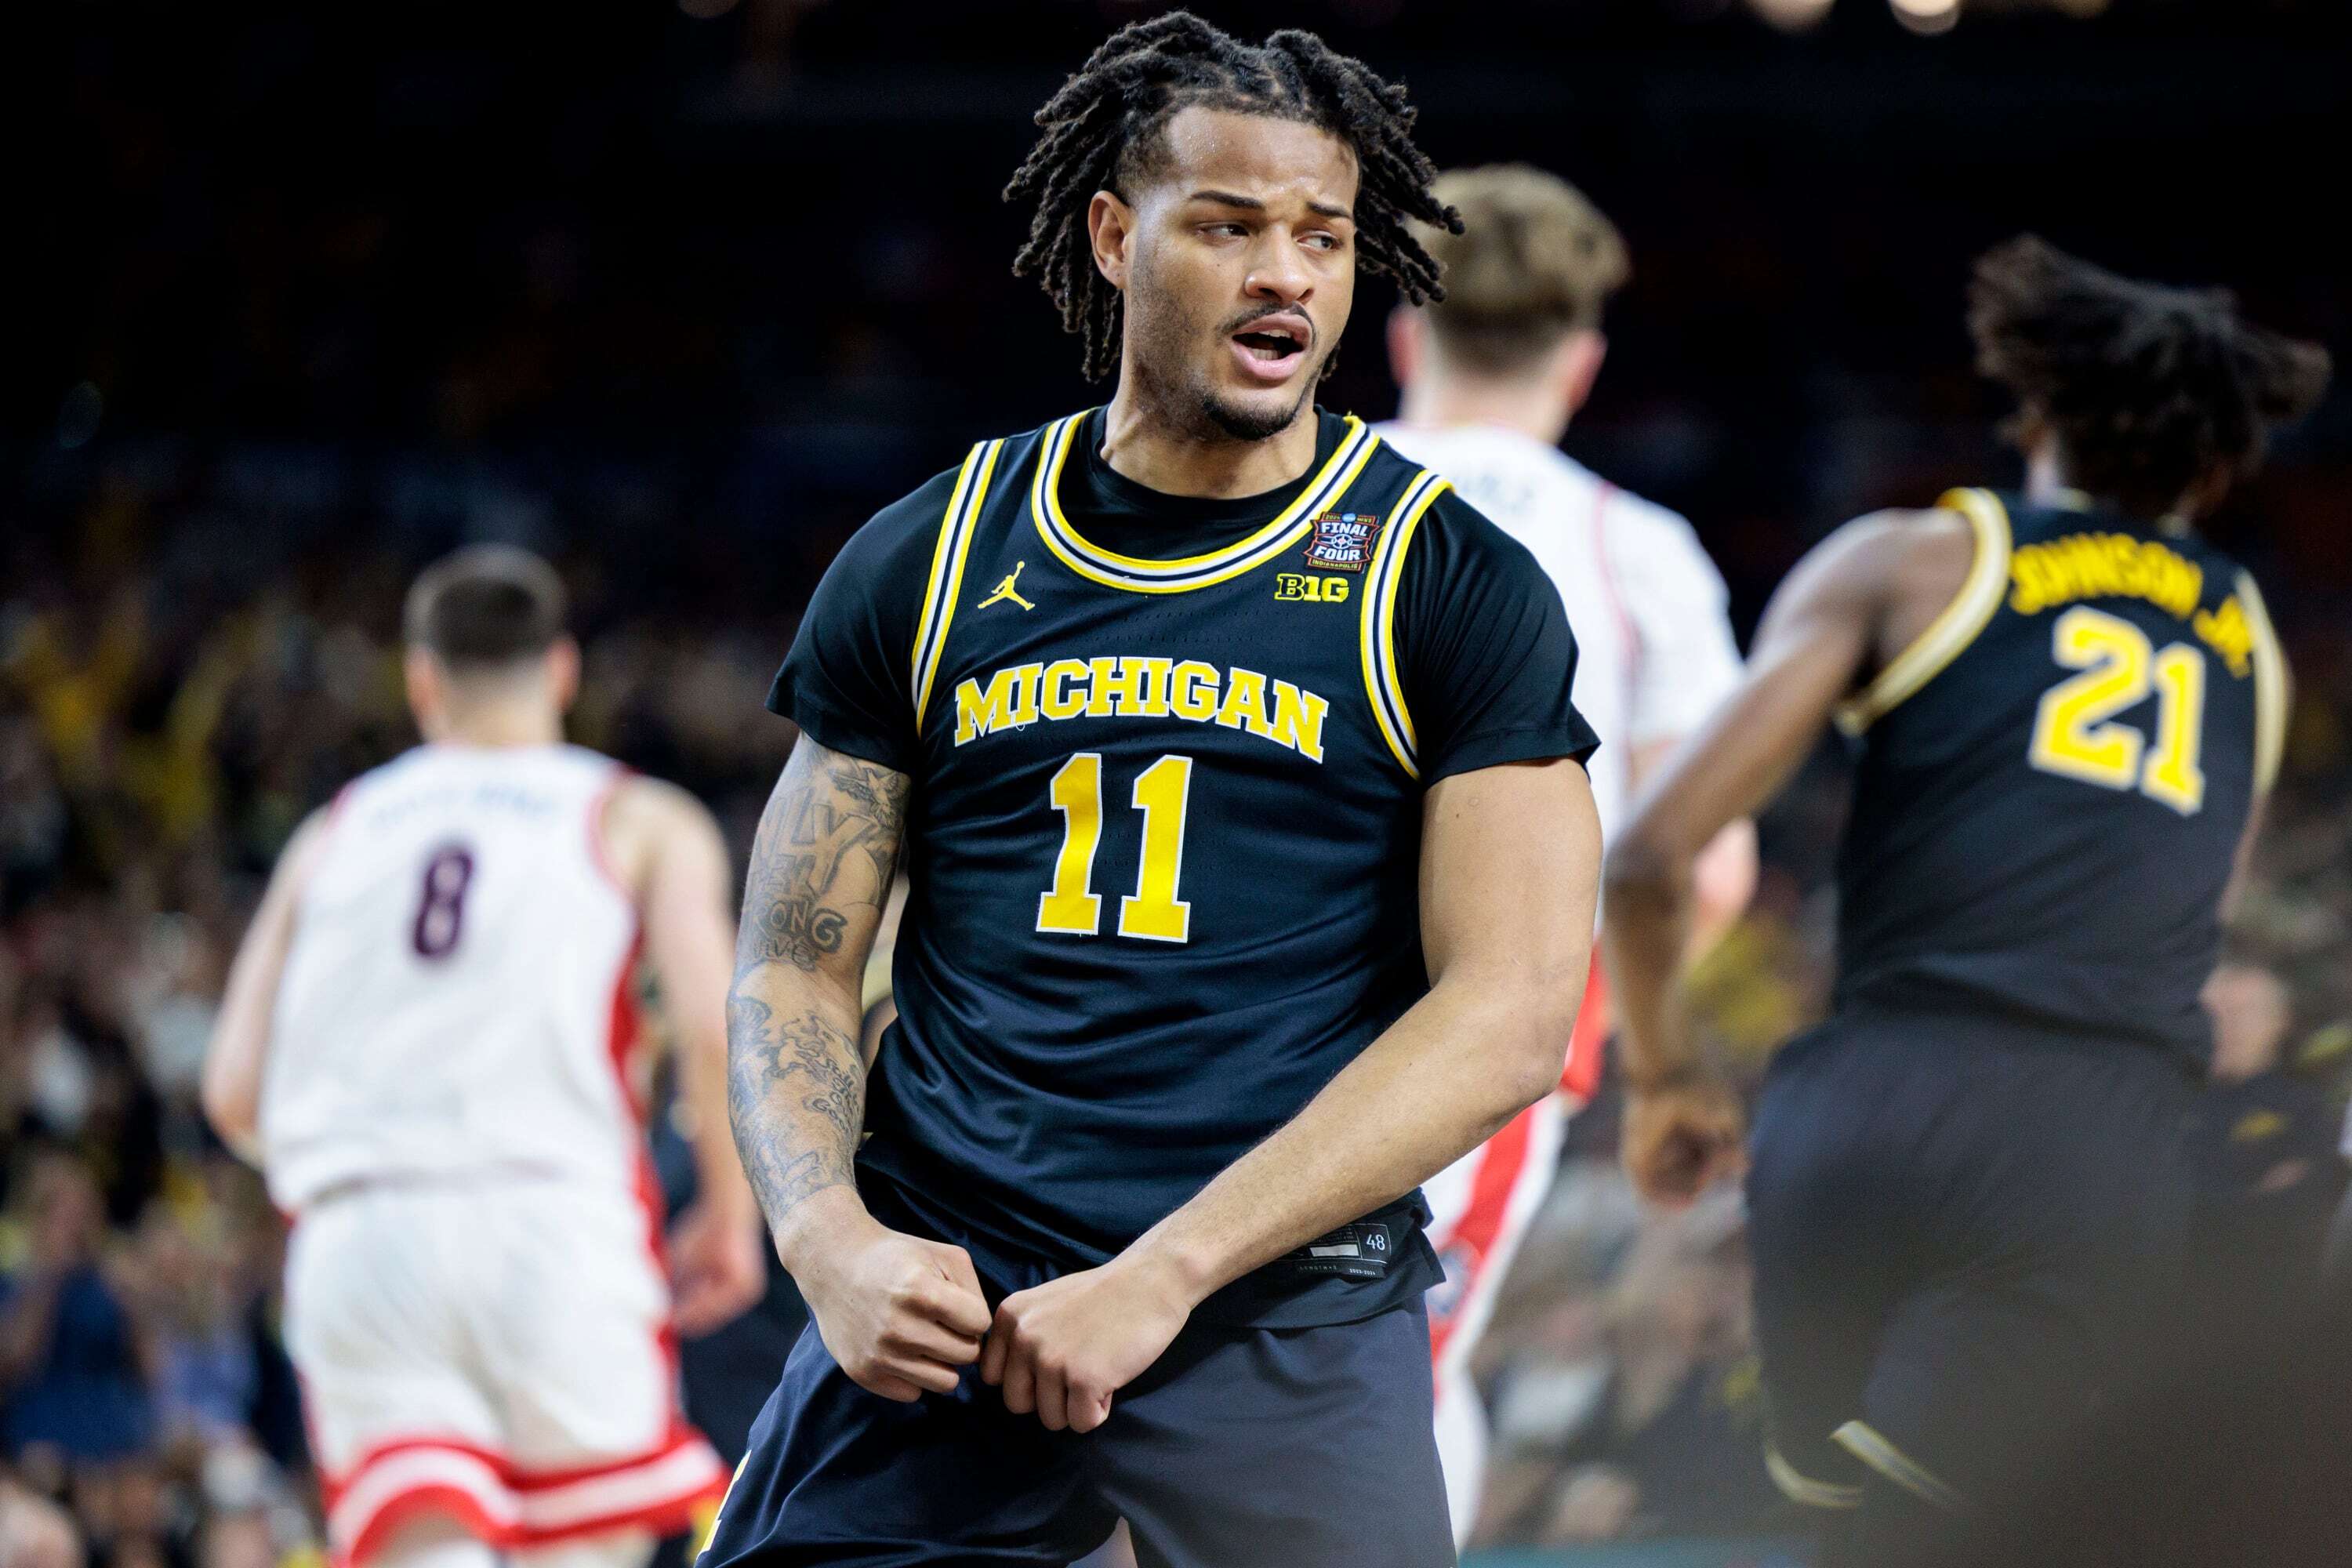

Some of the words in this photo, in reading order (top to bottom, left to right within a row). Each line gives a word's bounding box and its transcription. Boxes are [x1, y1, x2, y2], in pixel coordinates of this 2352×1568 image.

[1314, 545, 1360, 561] FOUR
[1321, 522, 1368, 537] FINAL
[1312, 559, 1359, 570] INDIANAPOLIS
[954, 657, 1330, 764] MICHIGAN
[2027, 604, 2206, 816] 21
[1036, 753, 1193, 943] 11
[411, 840, 474, 961] 8
[1367, 1234, 1385, 1250] 48
